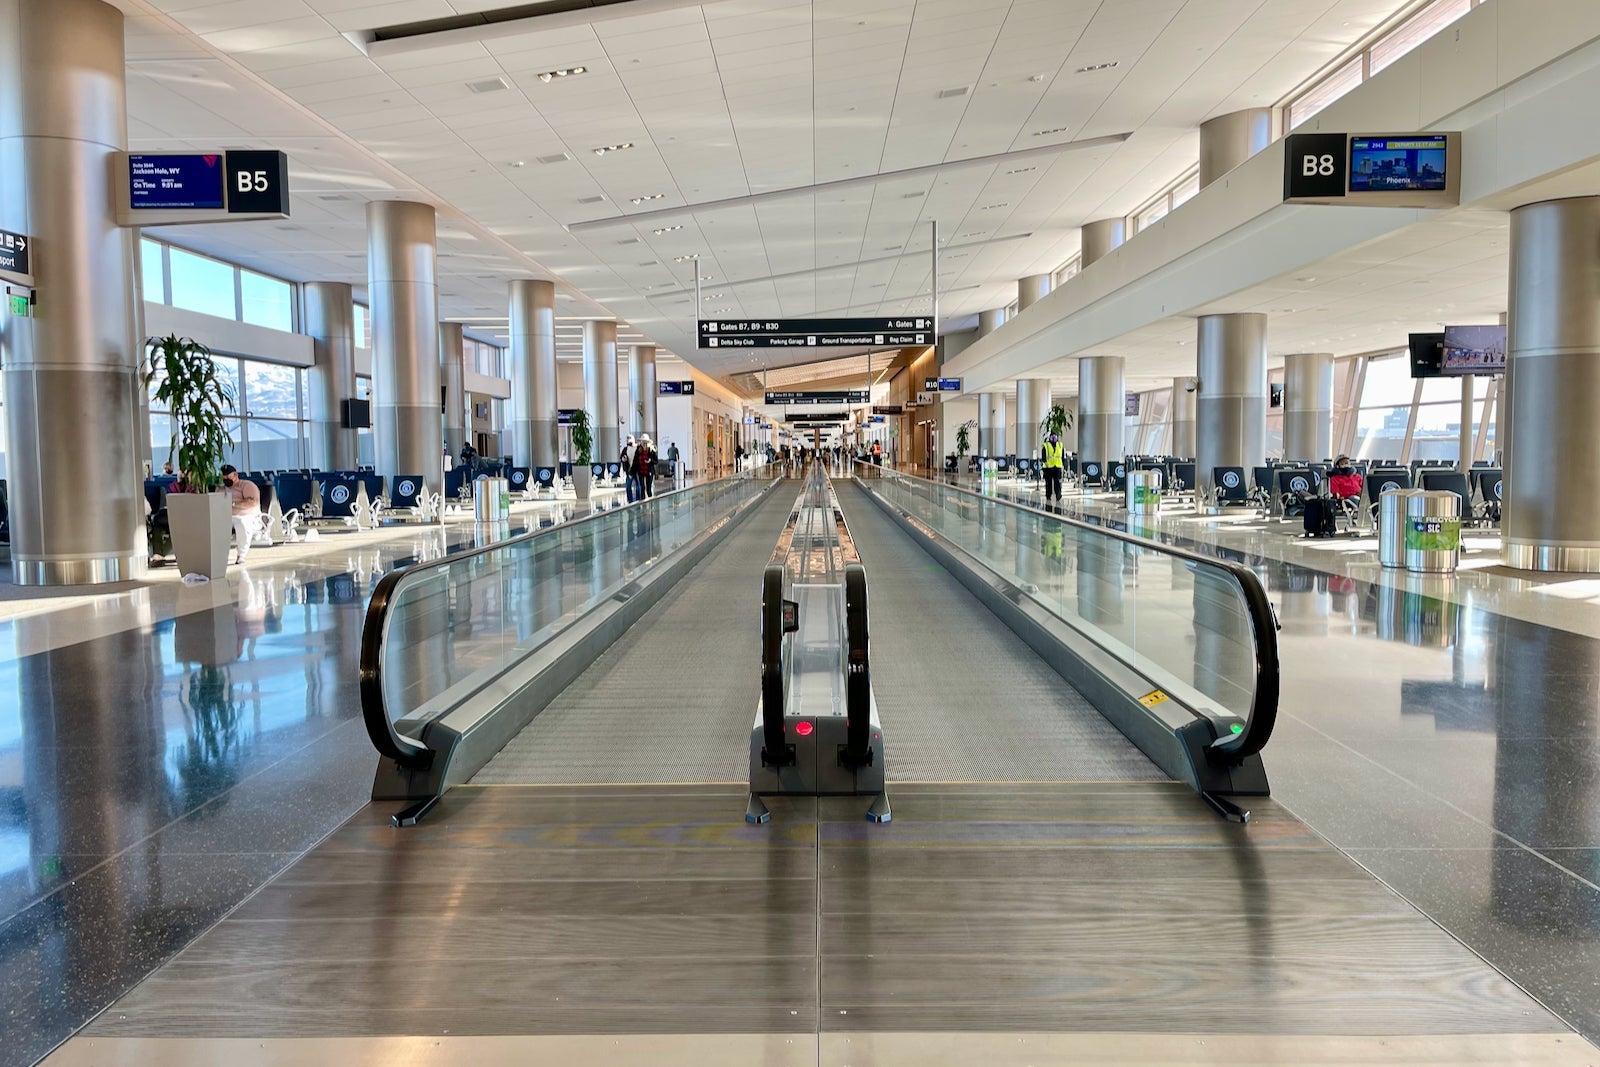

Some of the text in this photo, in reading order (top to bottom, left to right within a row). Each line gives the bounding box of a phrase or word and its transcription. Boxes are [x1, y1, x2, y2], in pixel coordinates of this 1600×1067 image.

[1303, 154, 1334, 176] B8
[238, 170, 268, 193] B5
[739, 323, 750, 331] B7,
[1428, 524, 1440, 533] SLC
